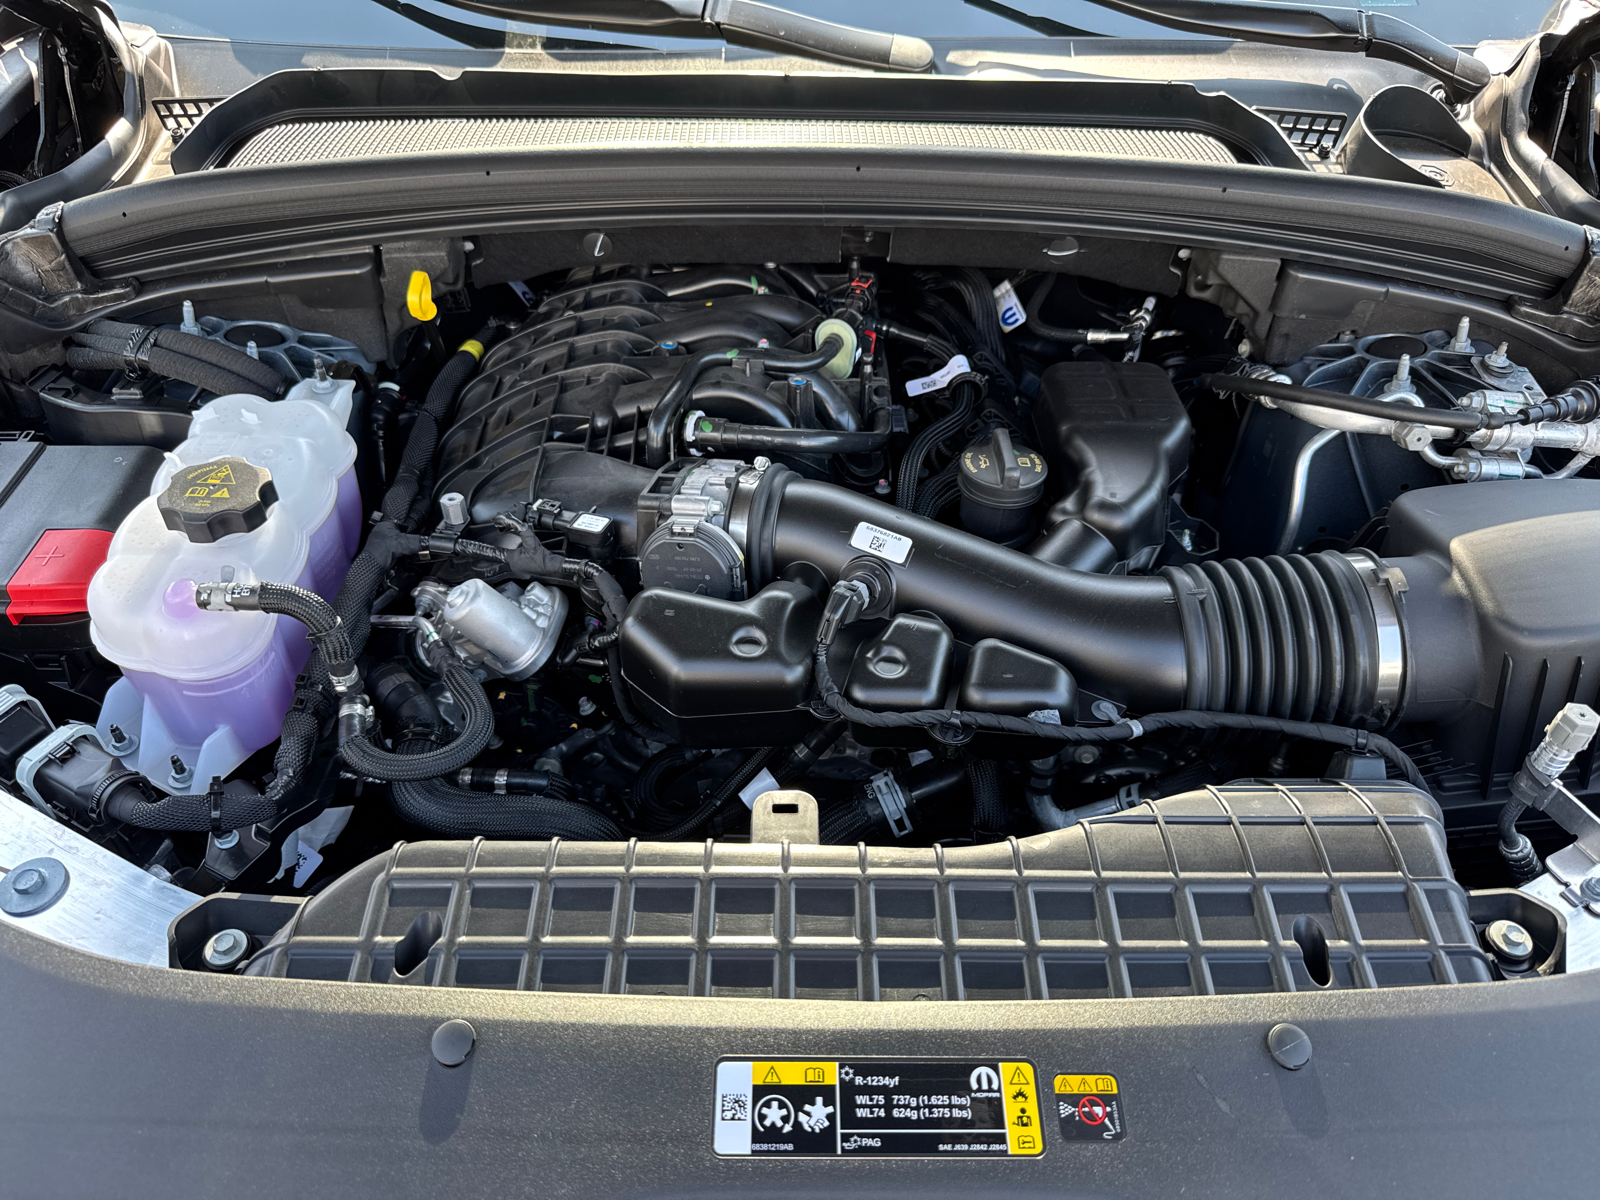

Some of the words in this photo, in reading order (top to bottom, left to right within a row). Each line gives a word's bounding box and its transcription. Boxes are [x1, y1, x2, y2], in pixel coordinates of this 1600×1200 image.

[854, 1075, 900, 1088] R-1234yf
[855, 1095, 885, 1105] WL75
[891, 1095, 917, 1107] 737g
[919, 1095, 950, 1107] (1.625
[951, 1095, 971, 1107] lbs)
[855, 1108, 886, 1118] WL74
[892, 1108, 918, 1120] 624g
[919, 1108, 950, 1120] (1.375
[952, 1108, 972, 1120] lbs)
[751, 1143, 794, 1151] 68381219AB
[861, 1137, 882, 1147] PAG
[938, 1143, 953, 1151] SAE
